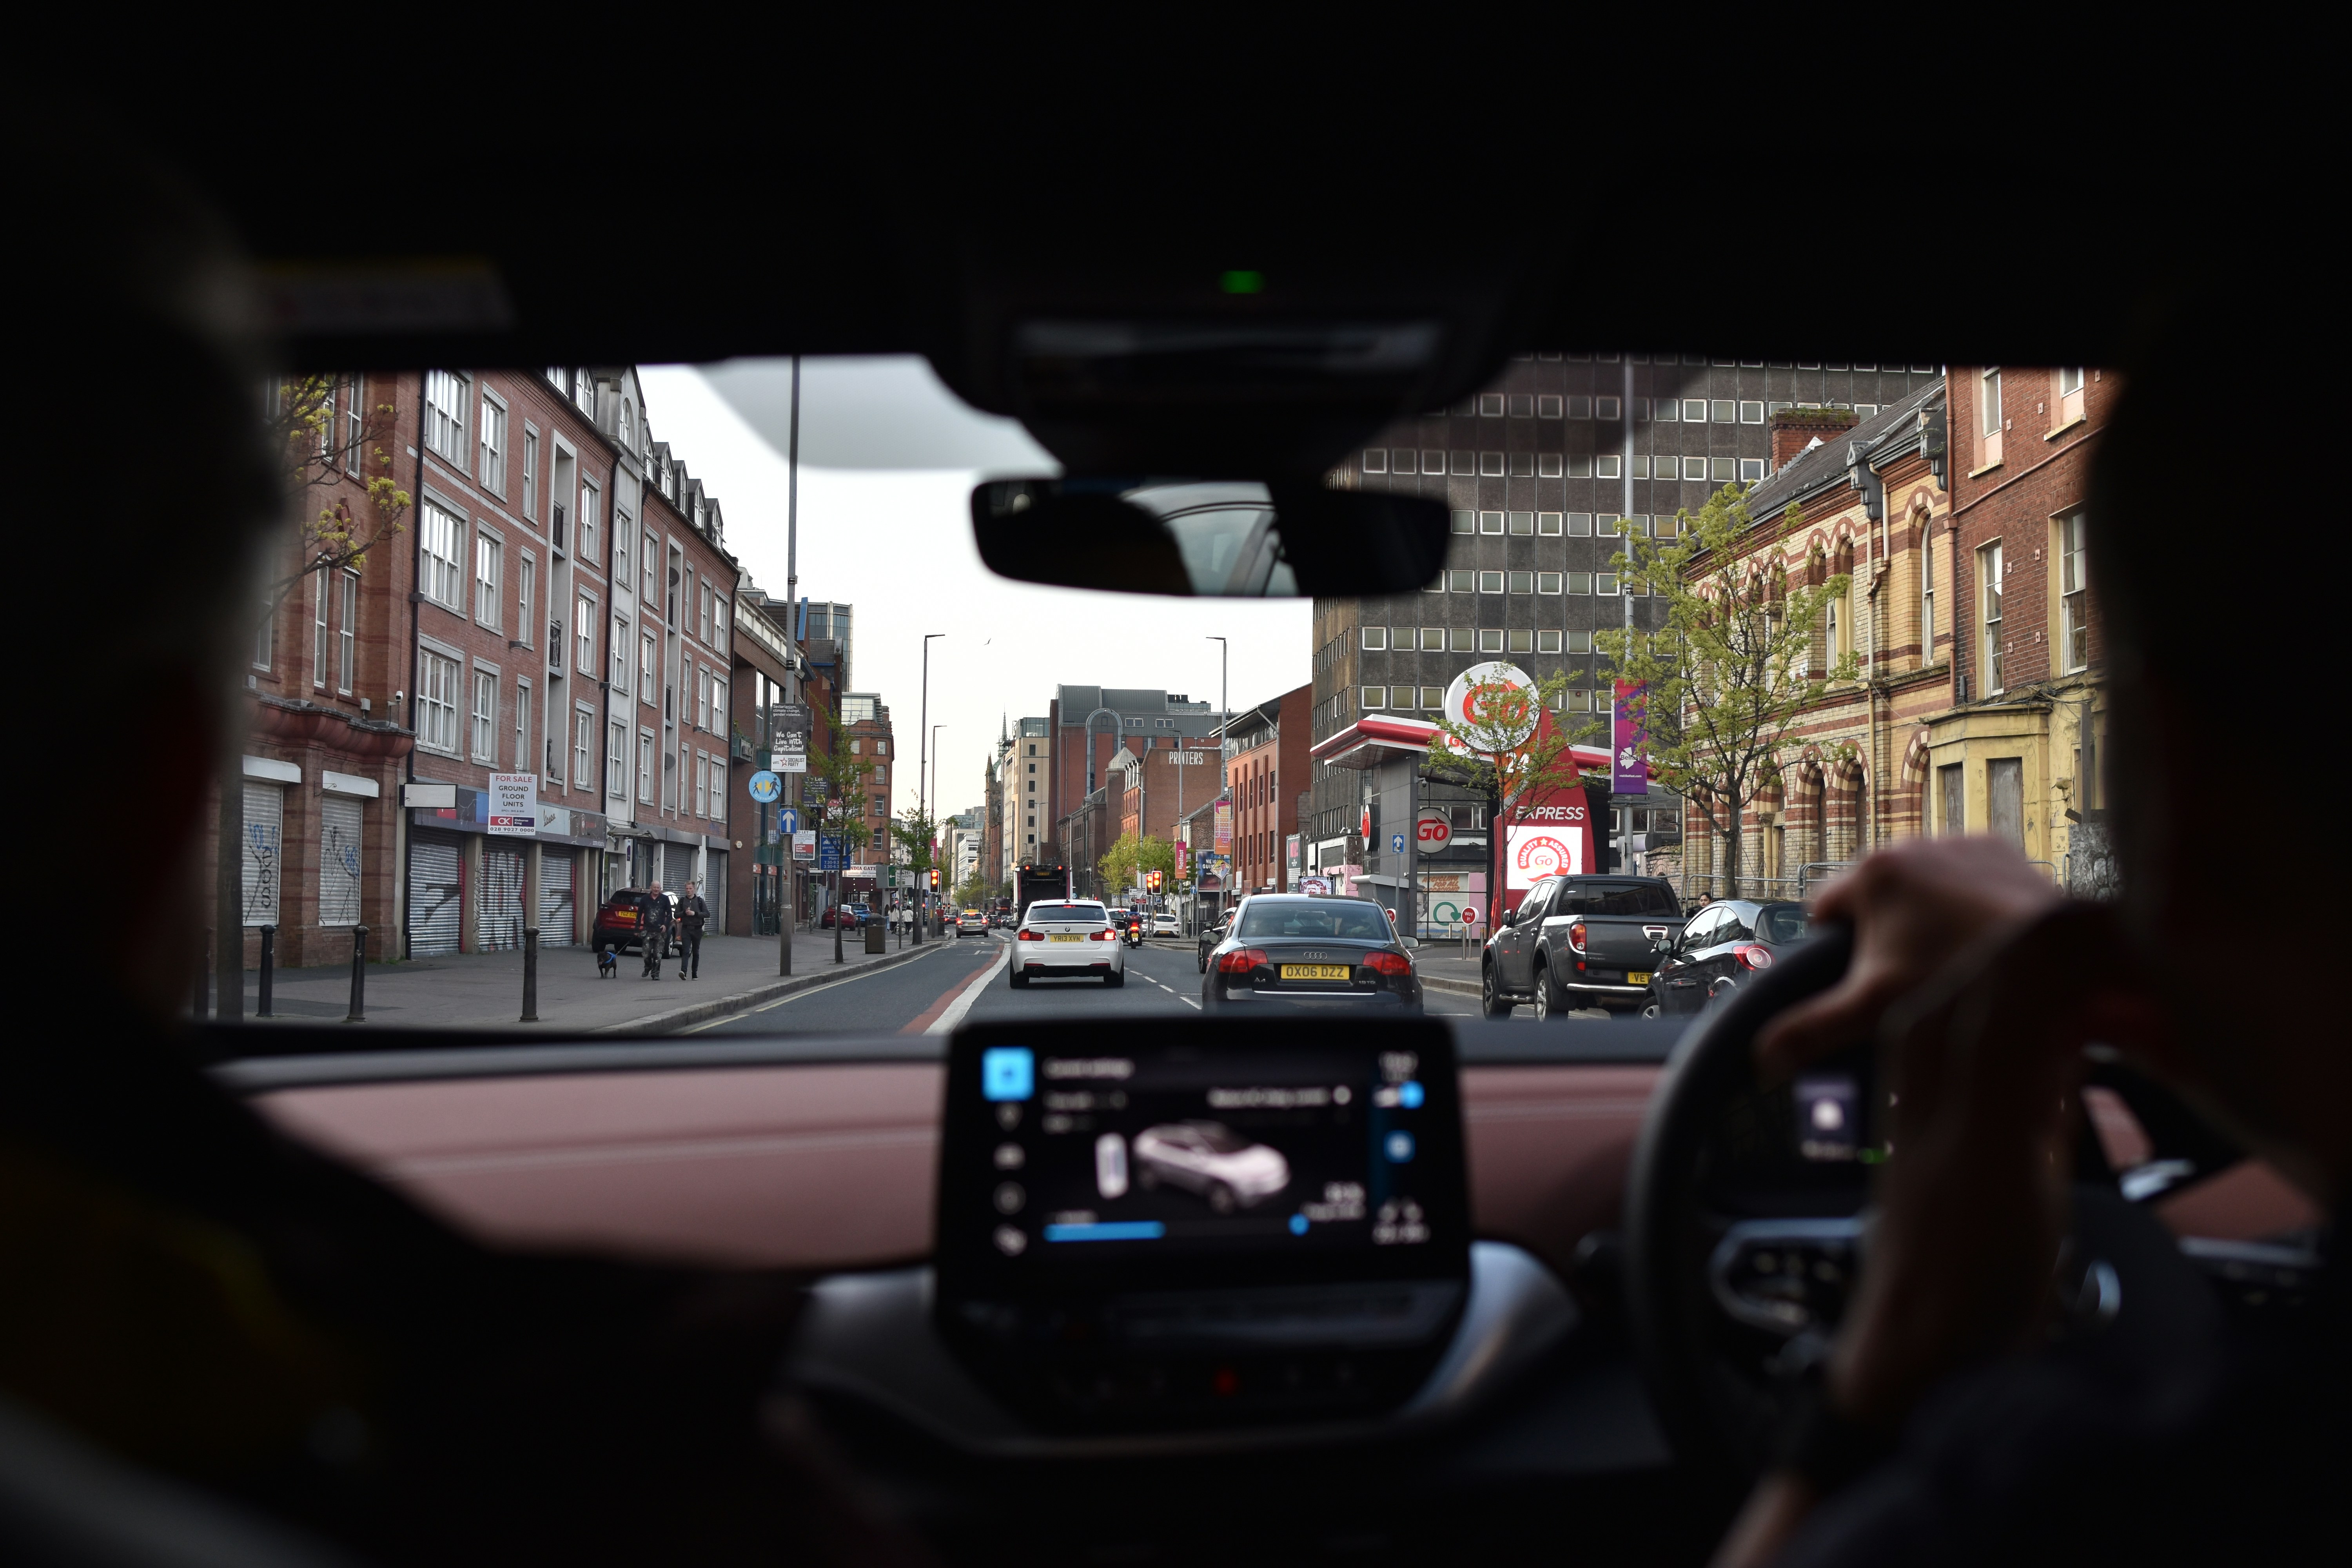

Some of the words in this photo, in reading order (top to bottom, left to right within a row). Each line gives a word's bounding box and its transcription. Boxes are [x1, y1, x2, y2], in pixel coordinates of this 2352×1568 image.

[774, 745, 804, 754] Capitalism!
[1169, 751, 1203, 765] PRINTERS
[1515, 806, 1584, 820] EXPRESS
[1520, 840, 1537, 866] QUALITY
[1548, 840, 1568, 868] ASSURED
[1286, 966, 1318, 977] OX06
[1321, 966, 1344, 977] DZZ
